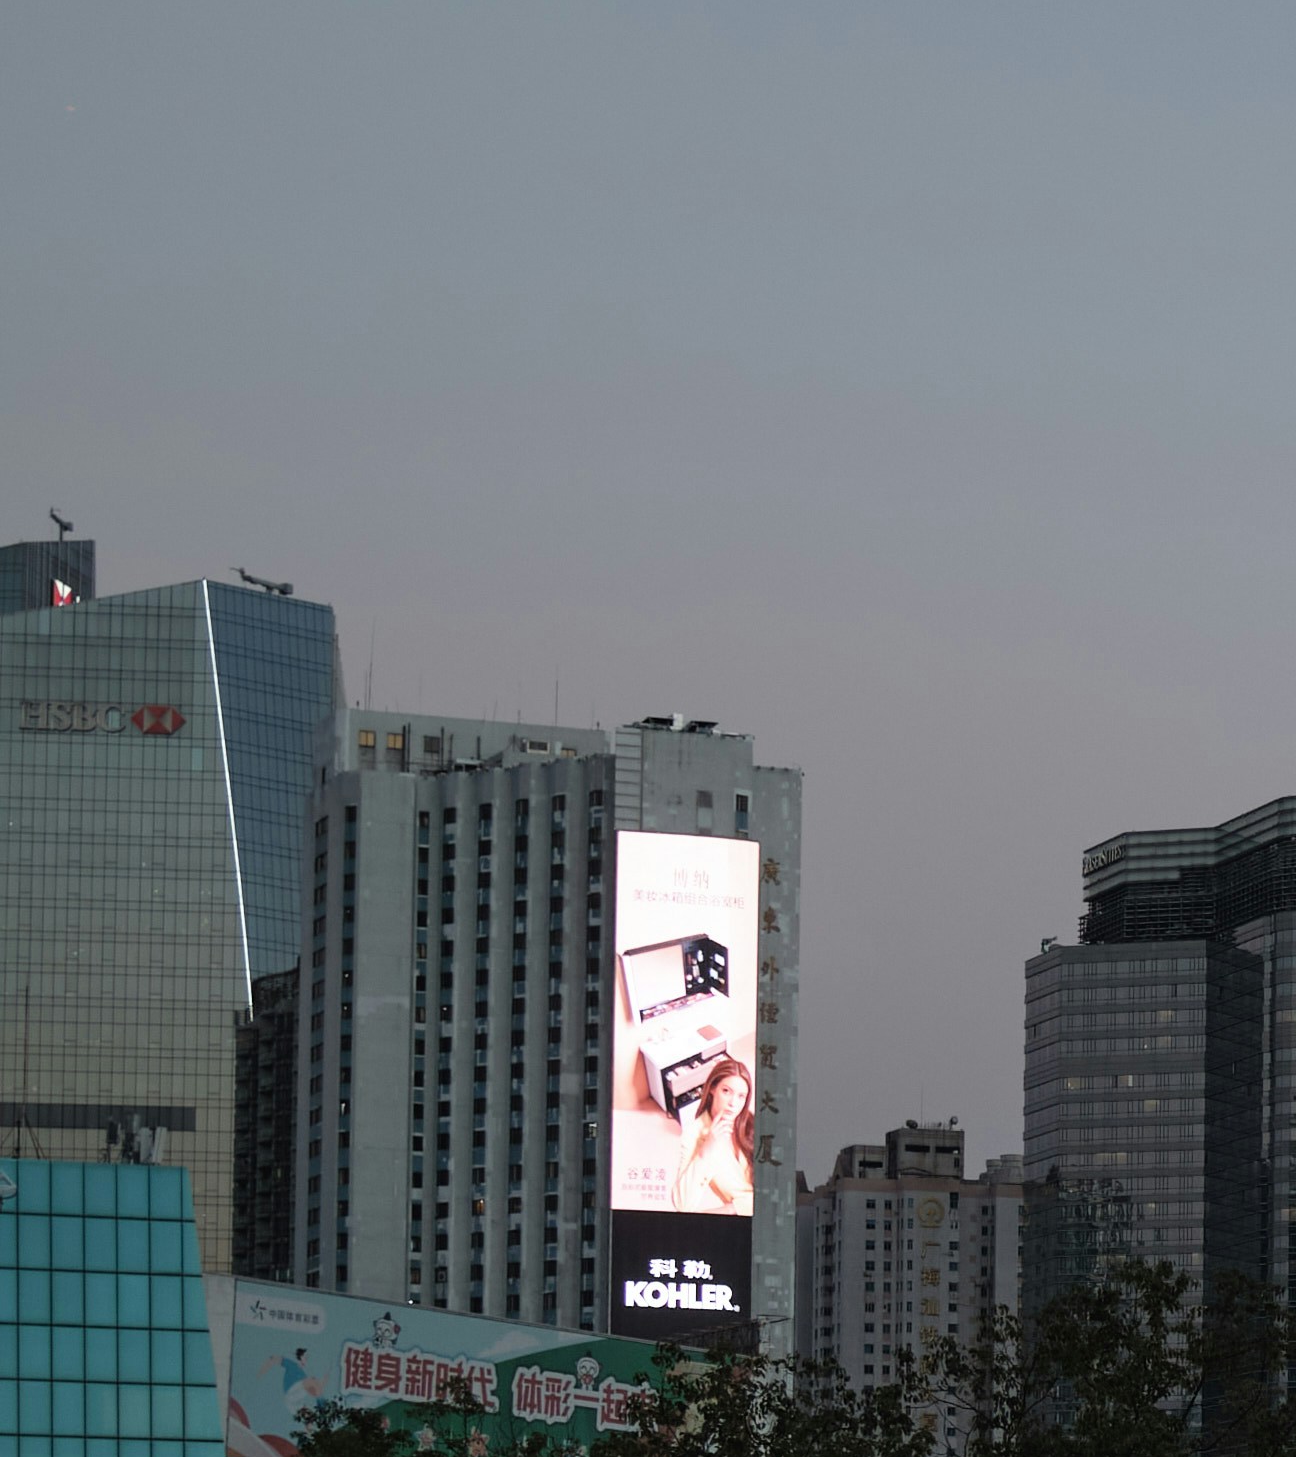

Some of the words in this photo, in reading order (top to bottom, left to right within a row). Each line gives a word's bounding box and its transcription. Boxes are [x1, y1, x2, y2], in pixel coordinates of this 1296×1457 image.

[19, 701, 126, 733] HSBC
[625, 1281, 735, 1311] KOHLER
[344, 1346, 496, 1409] 健身新时代
